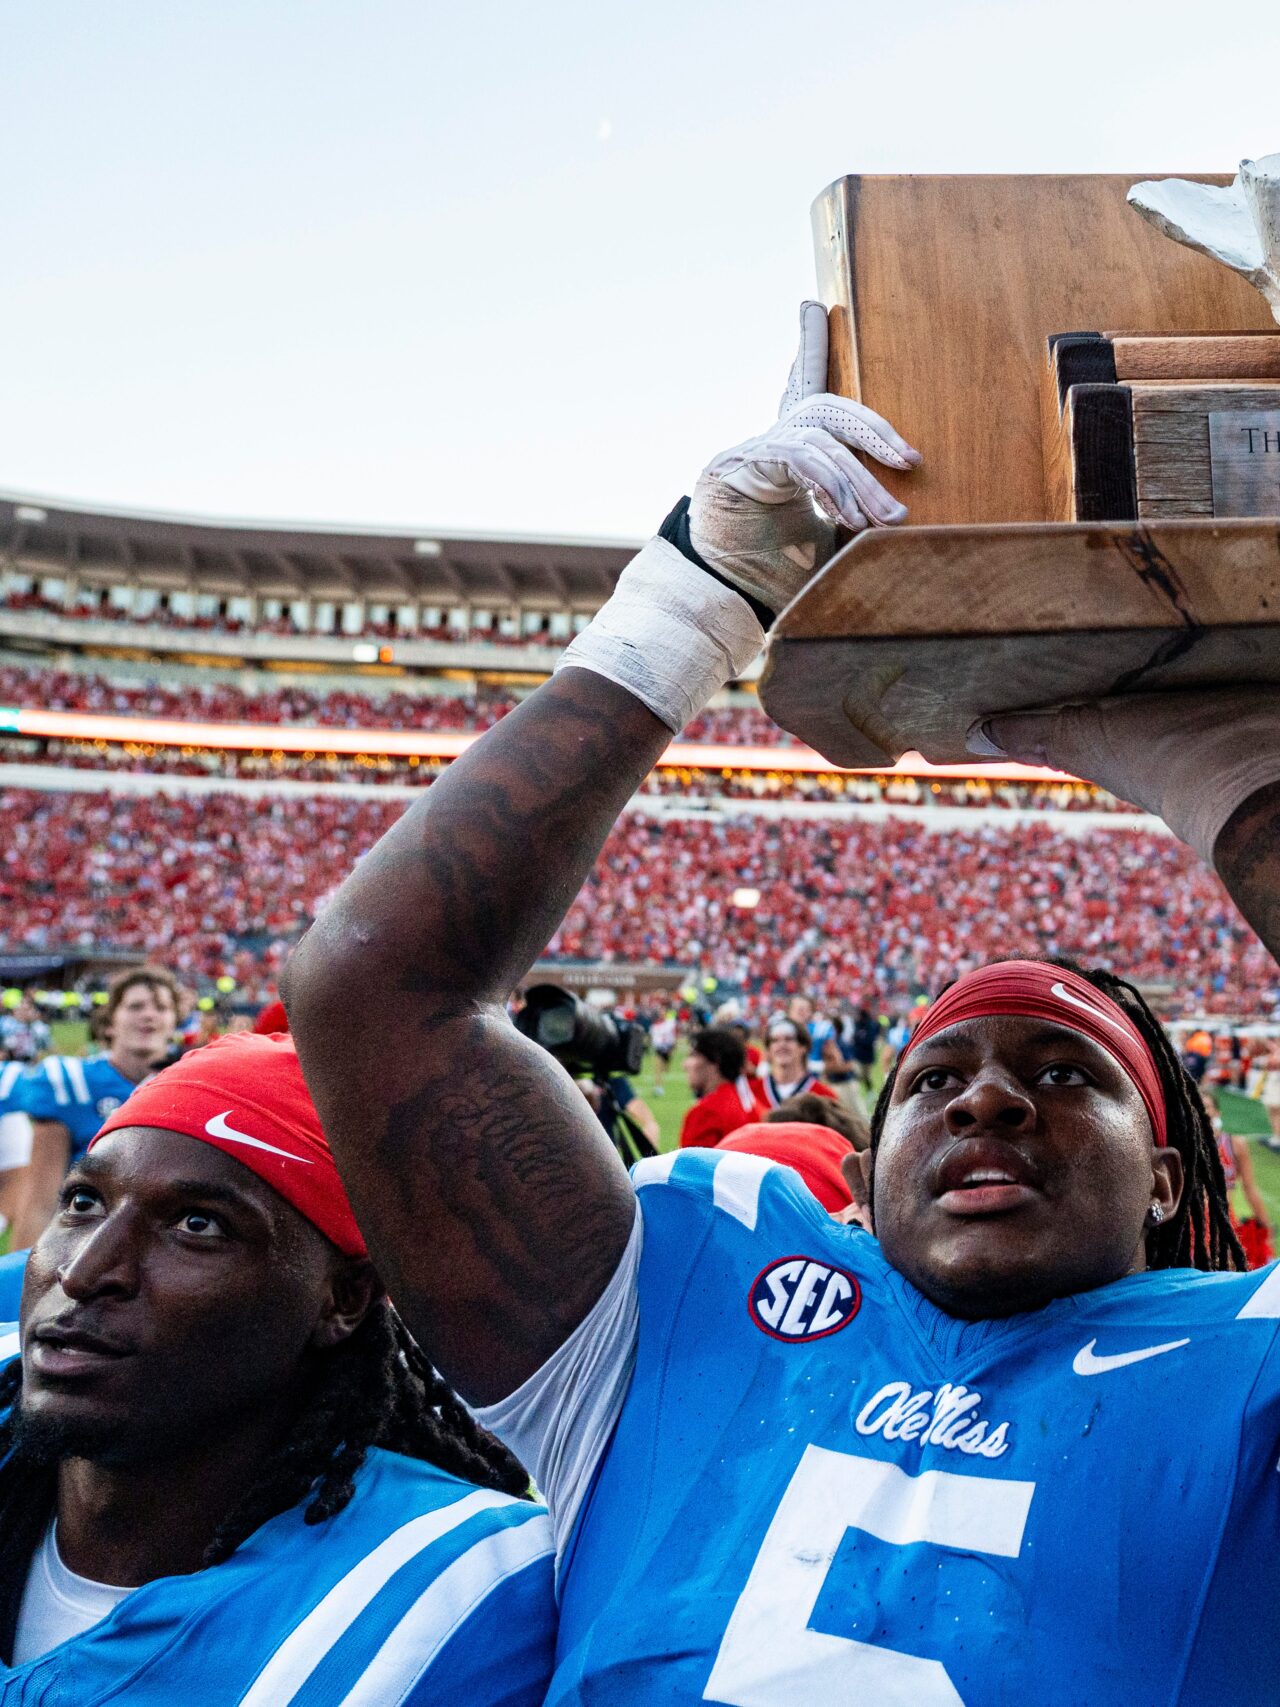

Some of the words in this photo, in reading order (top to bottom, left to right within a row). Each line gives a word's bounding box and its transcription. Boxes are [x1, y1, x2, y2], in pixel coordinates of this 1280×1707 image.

[756, 1259, 853, 1336] SEC
[855, 1381, 934, 1442] Ole
[919, 1382, 1010, 1458] Miss
[702, 1443, 1036, 1707] 5
